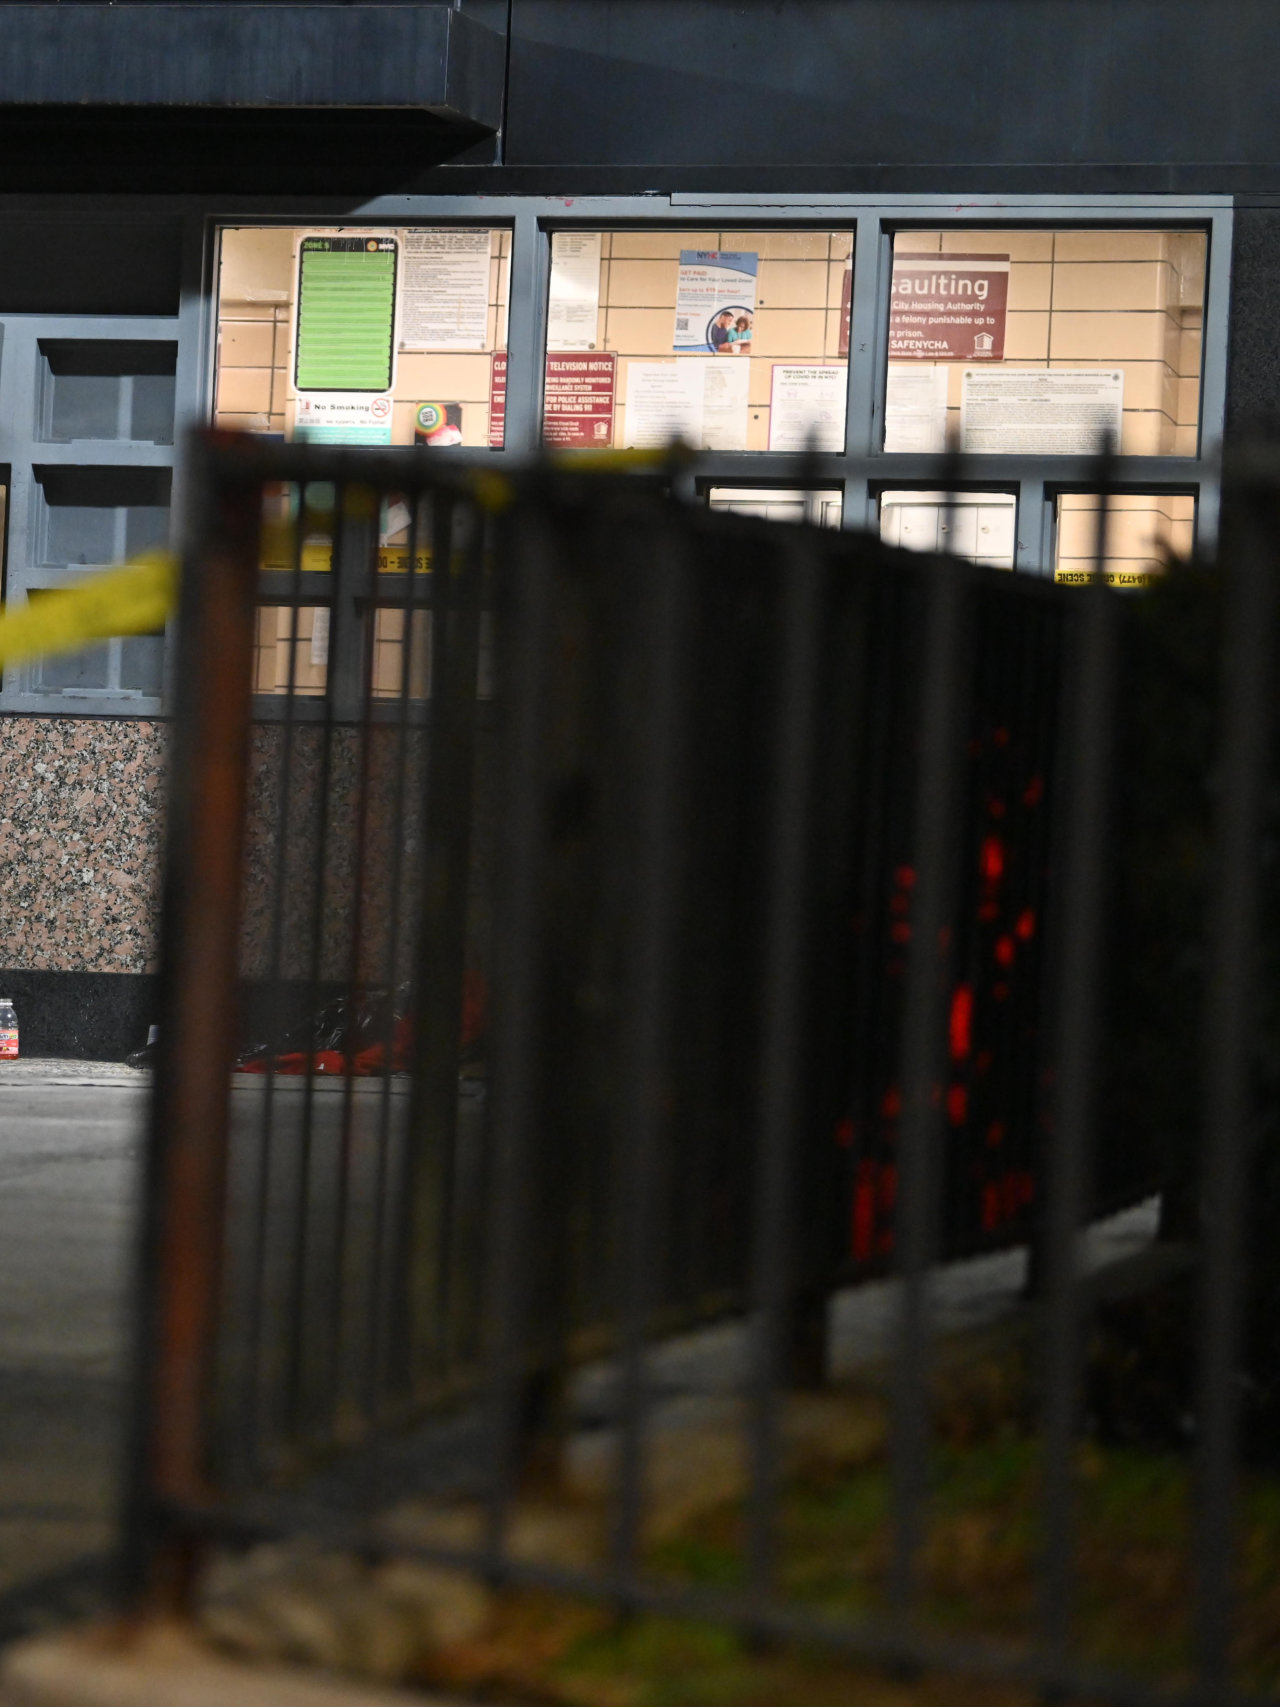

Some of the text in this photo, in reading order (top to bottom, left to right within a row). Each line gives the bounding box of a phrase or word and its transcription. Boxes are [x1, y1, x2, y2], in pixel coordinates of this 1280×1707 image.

[891, 274, 989, 300] saulting
[893, 300, 985, 311] City Housing Authority
[902, 314, 926, 324] felony
[928, 315, 972, 325] punishable
[974, 317, 985, 325] up
[986, 316, 995, 324] to
[897, 330, 924, 338] prison.
[891, 340, 949, 349] SAFENYCHA
[494, 361, 614, 371] CLO TELEVISION NOTICE
[329, 403, 370, 412] Smoking
[1057, 572, 1085, 583] SCENE
